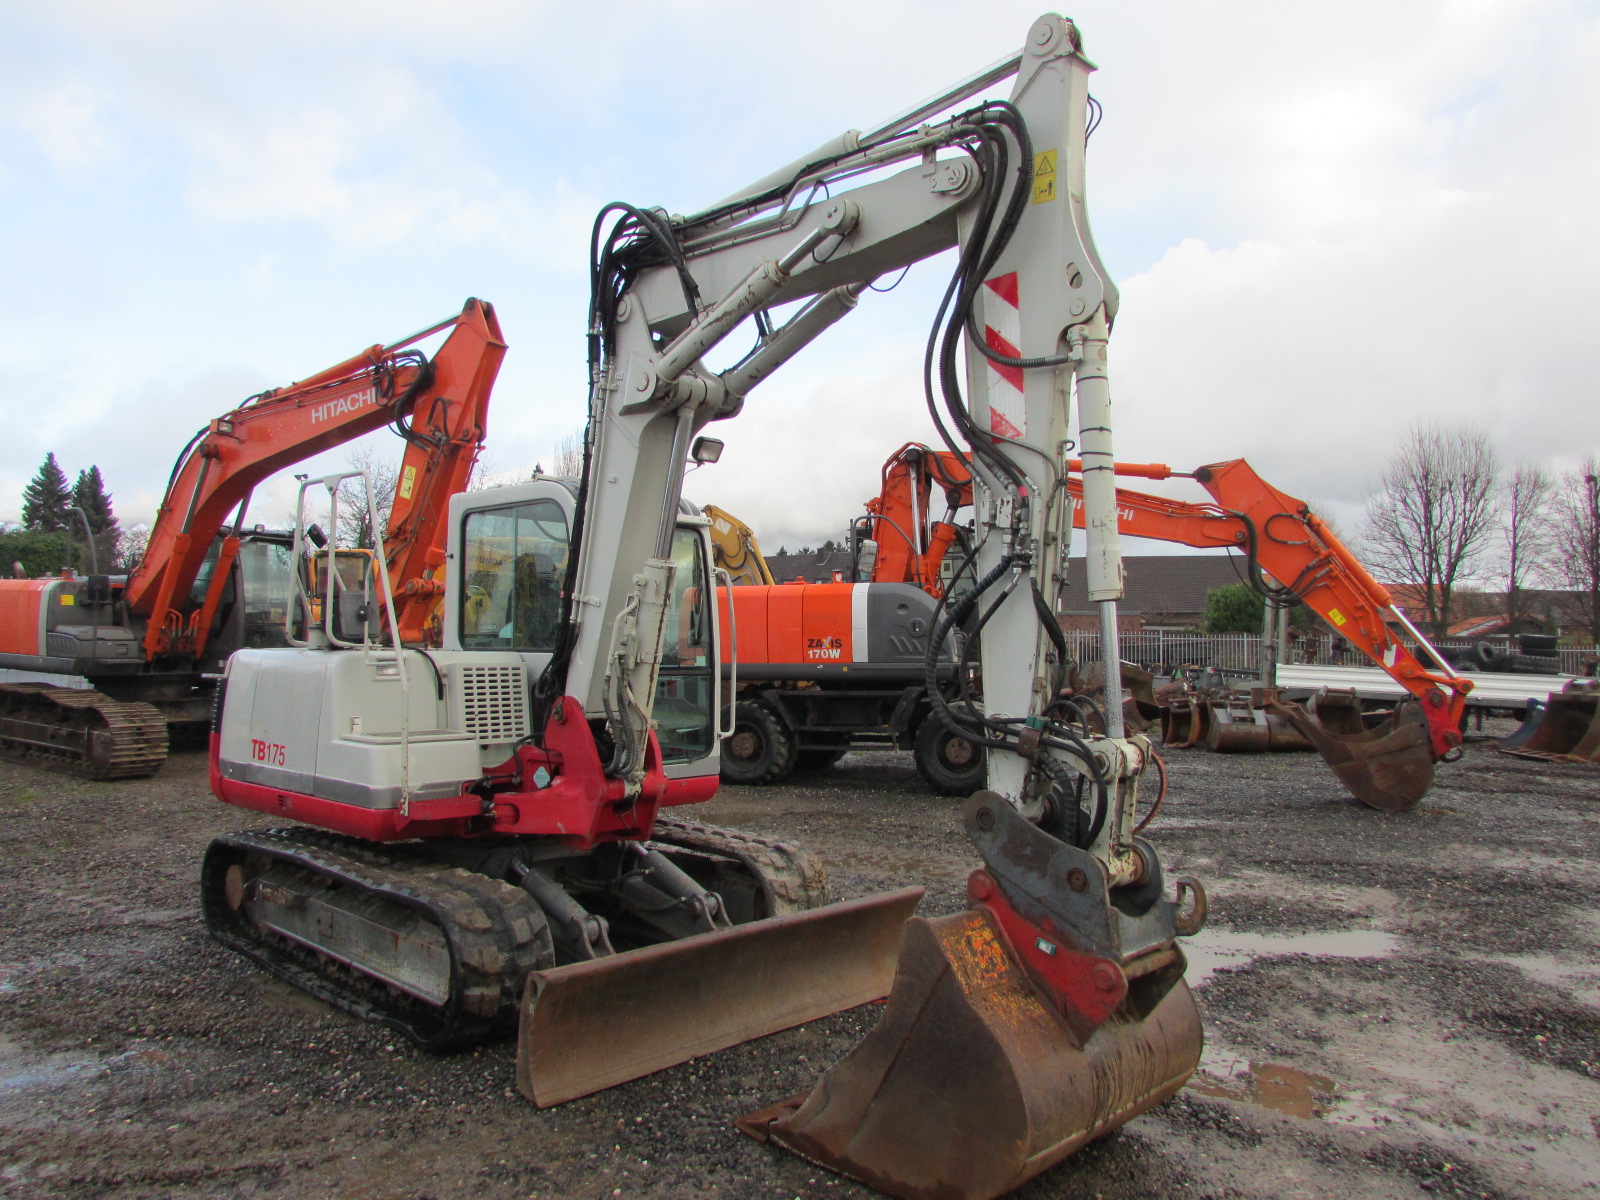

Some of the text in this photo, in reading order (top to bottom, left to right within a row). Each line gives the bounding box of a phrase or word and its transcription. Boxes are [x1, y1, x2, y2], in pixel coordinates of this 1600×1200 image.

[311, 387, 377, 424] HITACHI
[807, 636, 843, 649] ZAXIS
[807, 648, 841, 659] 170W
[251, 738, 286, 766] TB175
